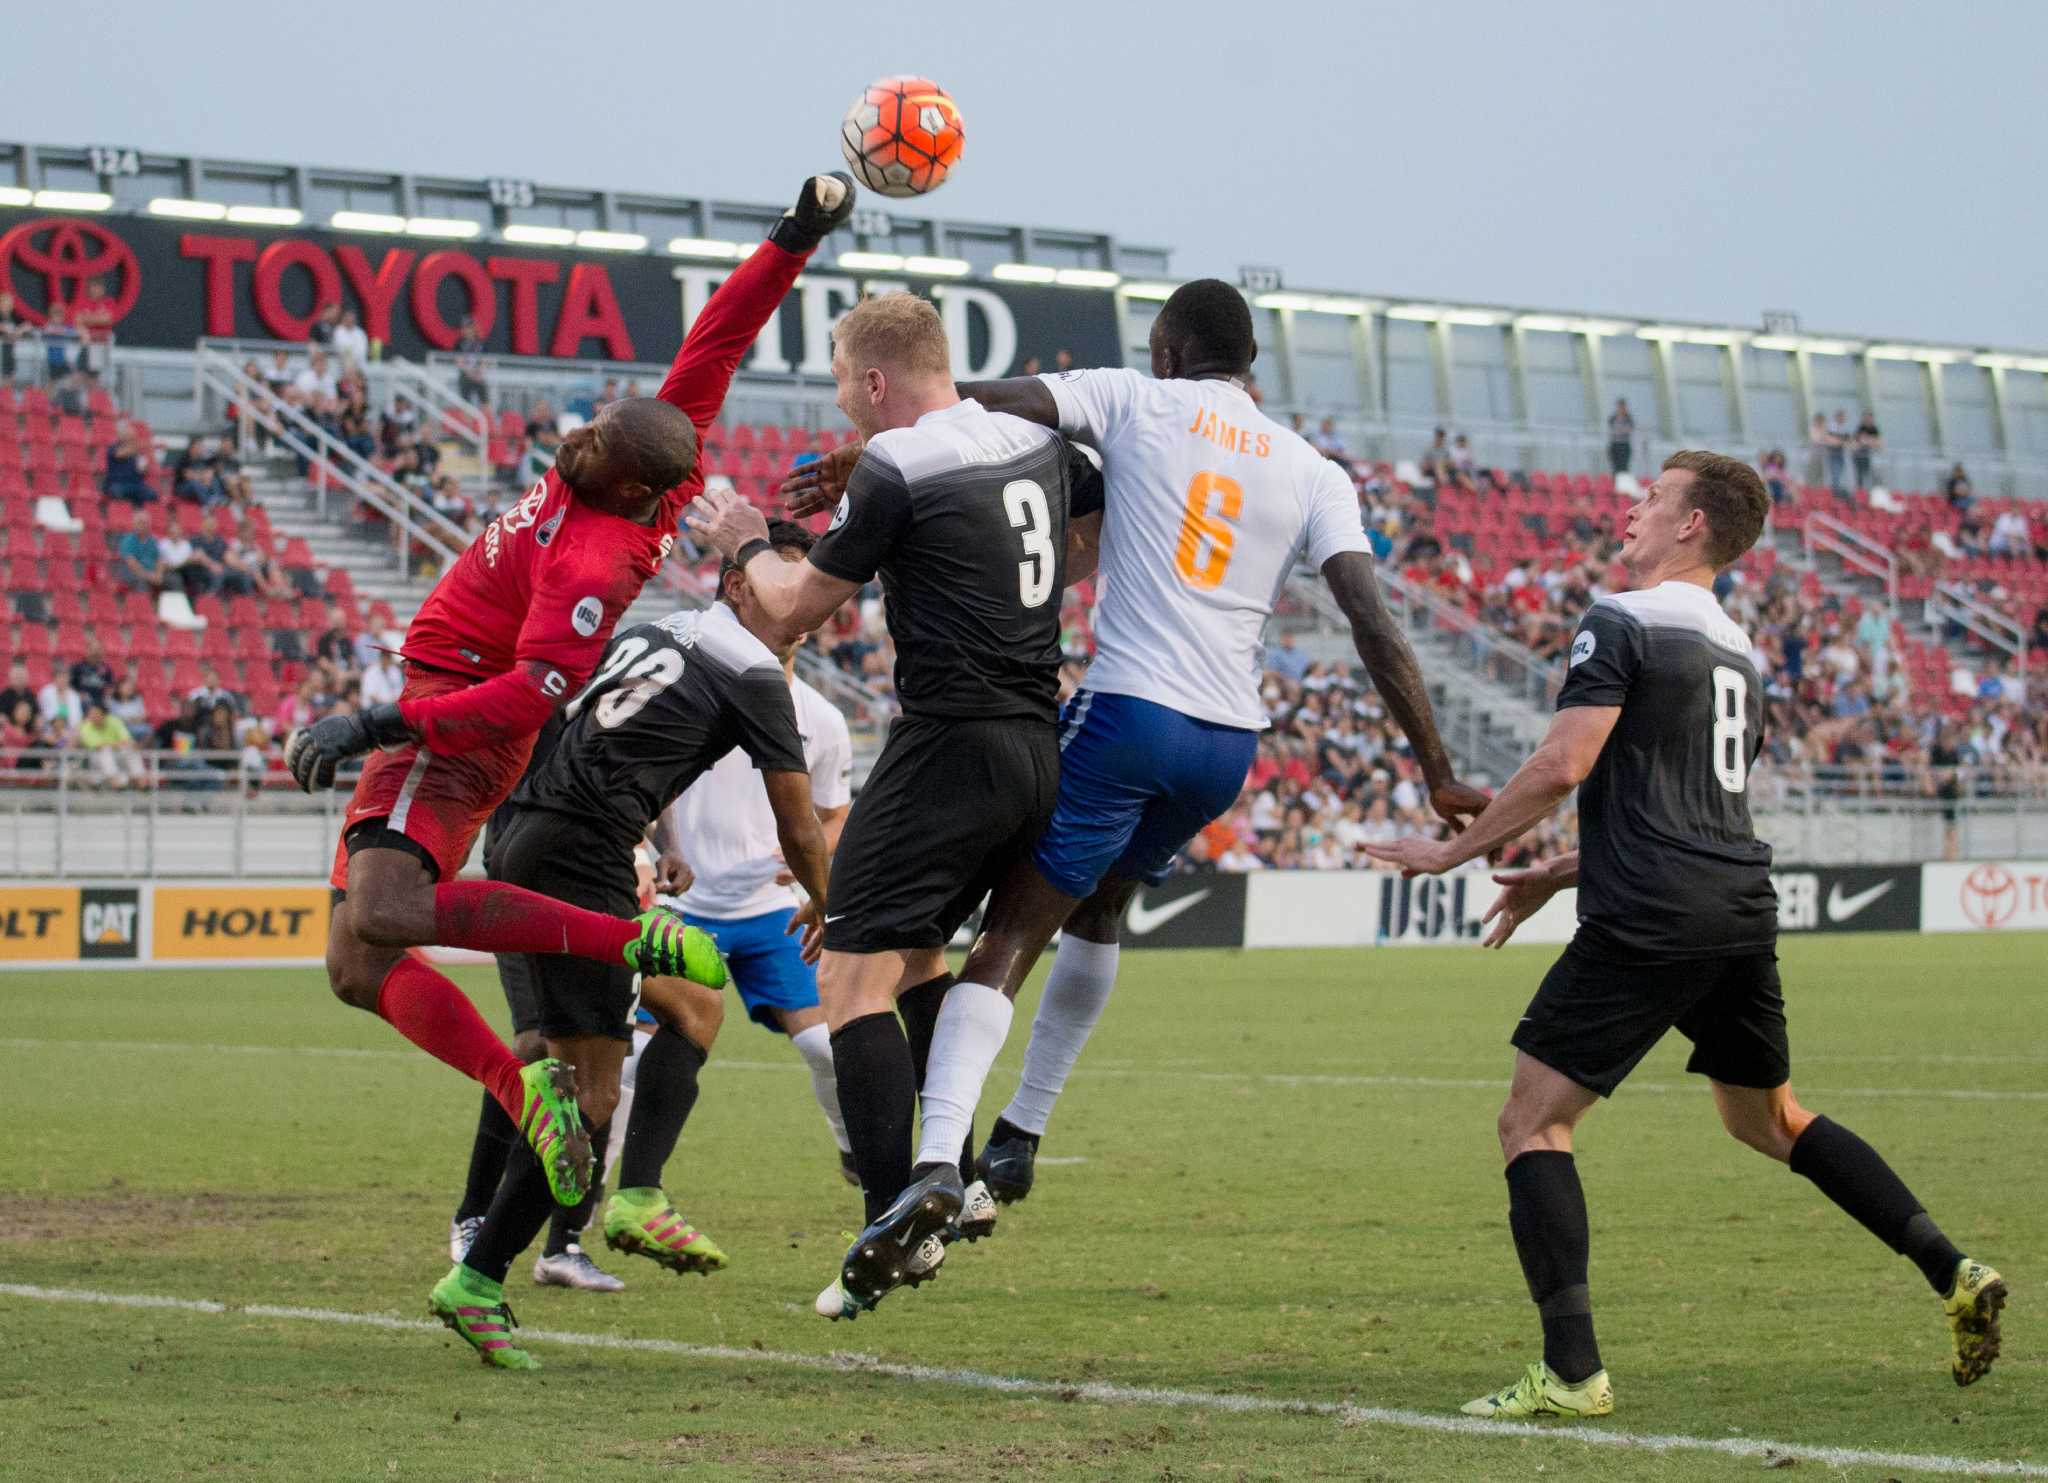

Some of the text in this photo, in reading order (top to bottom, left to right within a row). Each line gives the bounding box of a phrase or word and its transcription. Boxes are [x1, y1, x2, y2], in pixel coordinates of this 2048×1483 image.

[89, 148, 140, 176] 124
[181, 234, 635, 360] TOYOTA
[1189, 404, 1271, 458] JAMES
[1003, 479, 1056, 608] 3
[1174, 471, 1244, 592] 6
[1713, 665, 1748, 793] 8
[0, 908, 62, 937] LT
[83, 902, 136, 944] CAT
[182, 908, 313, 938] HOLT
[1379, 877, 1482, 938] USL
[1768, 872, 1820, 930] ER
